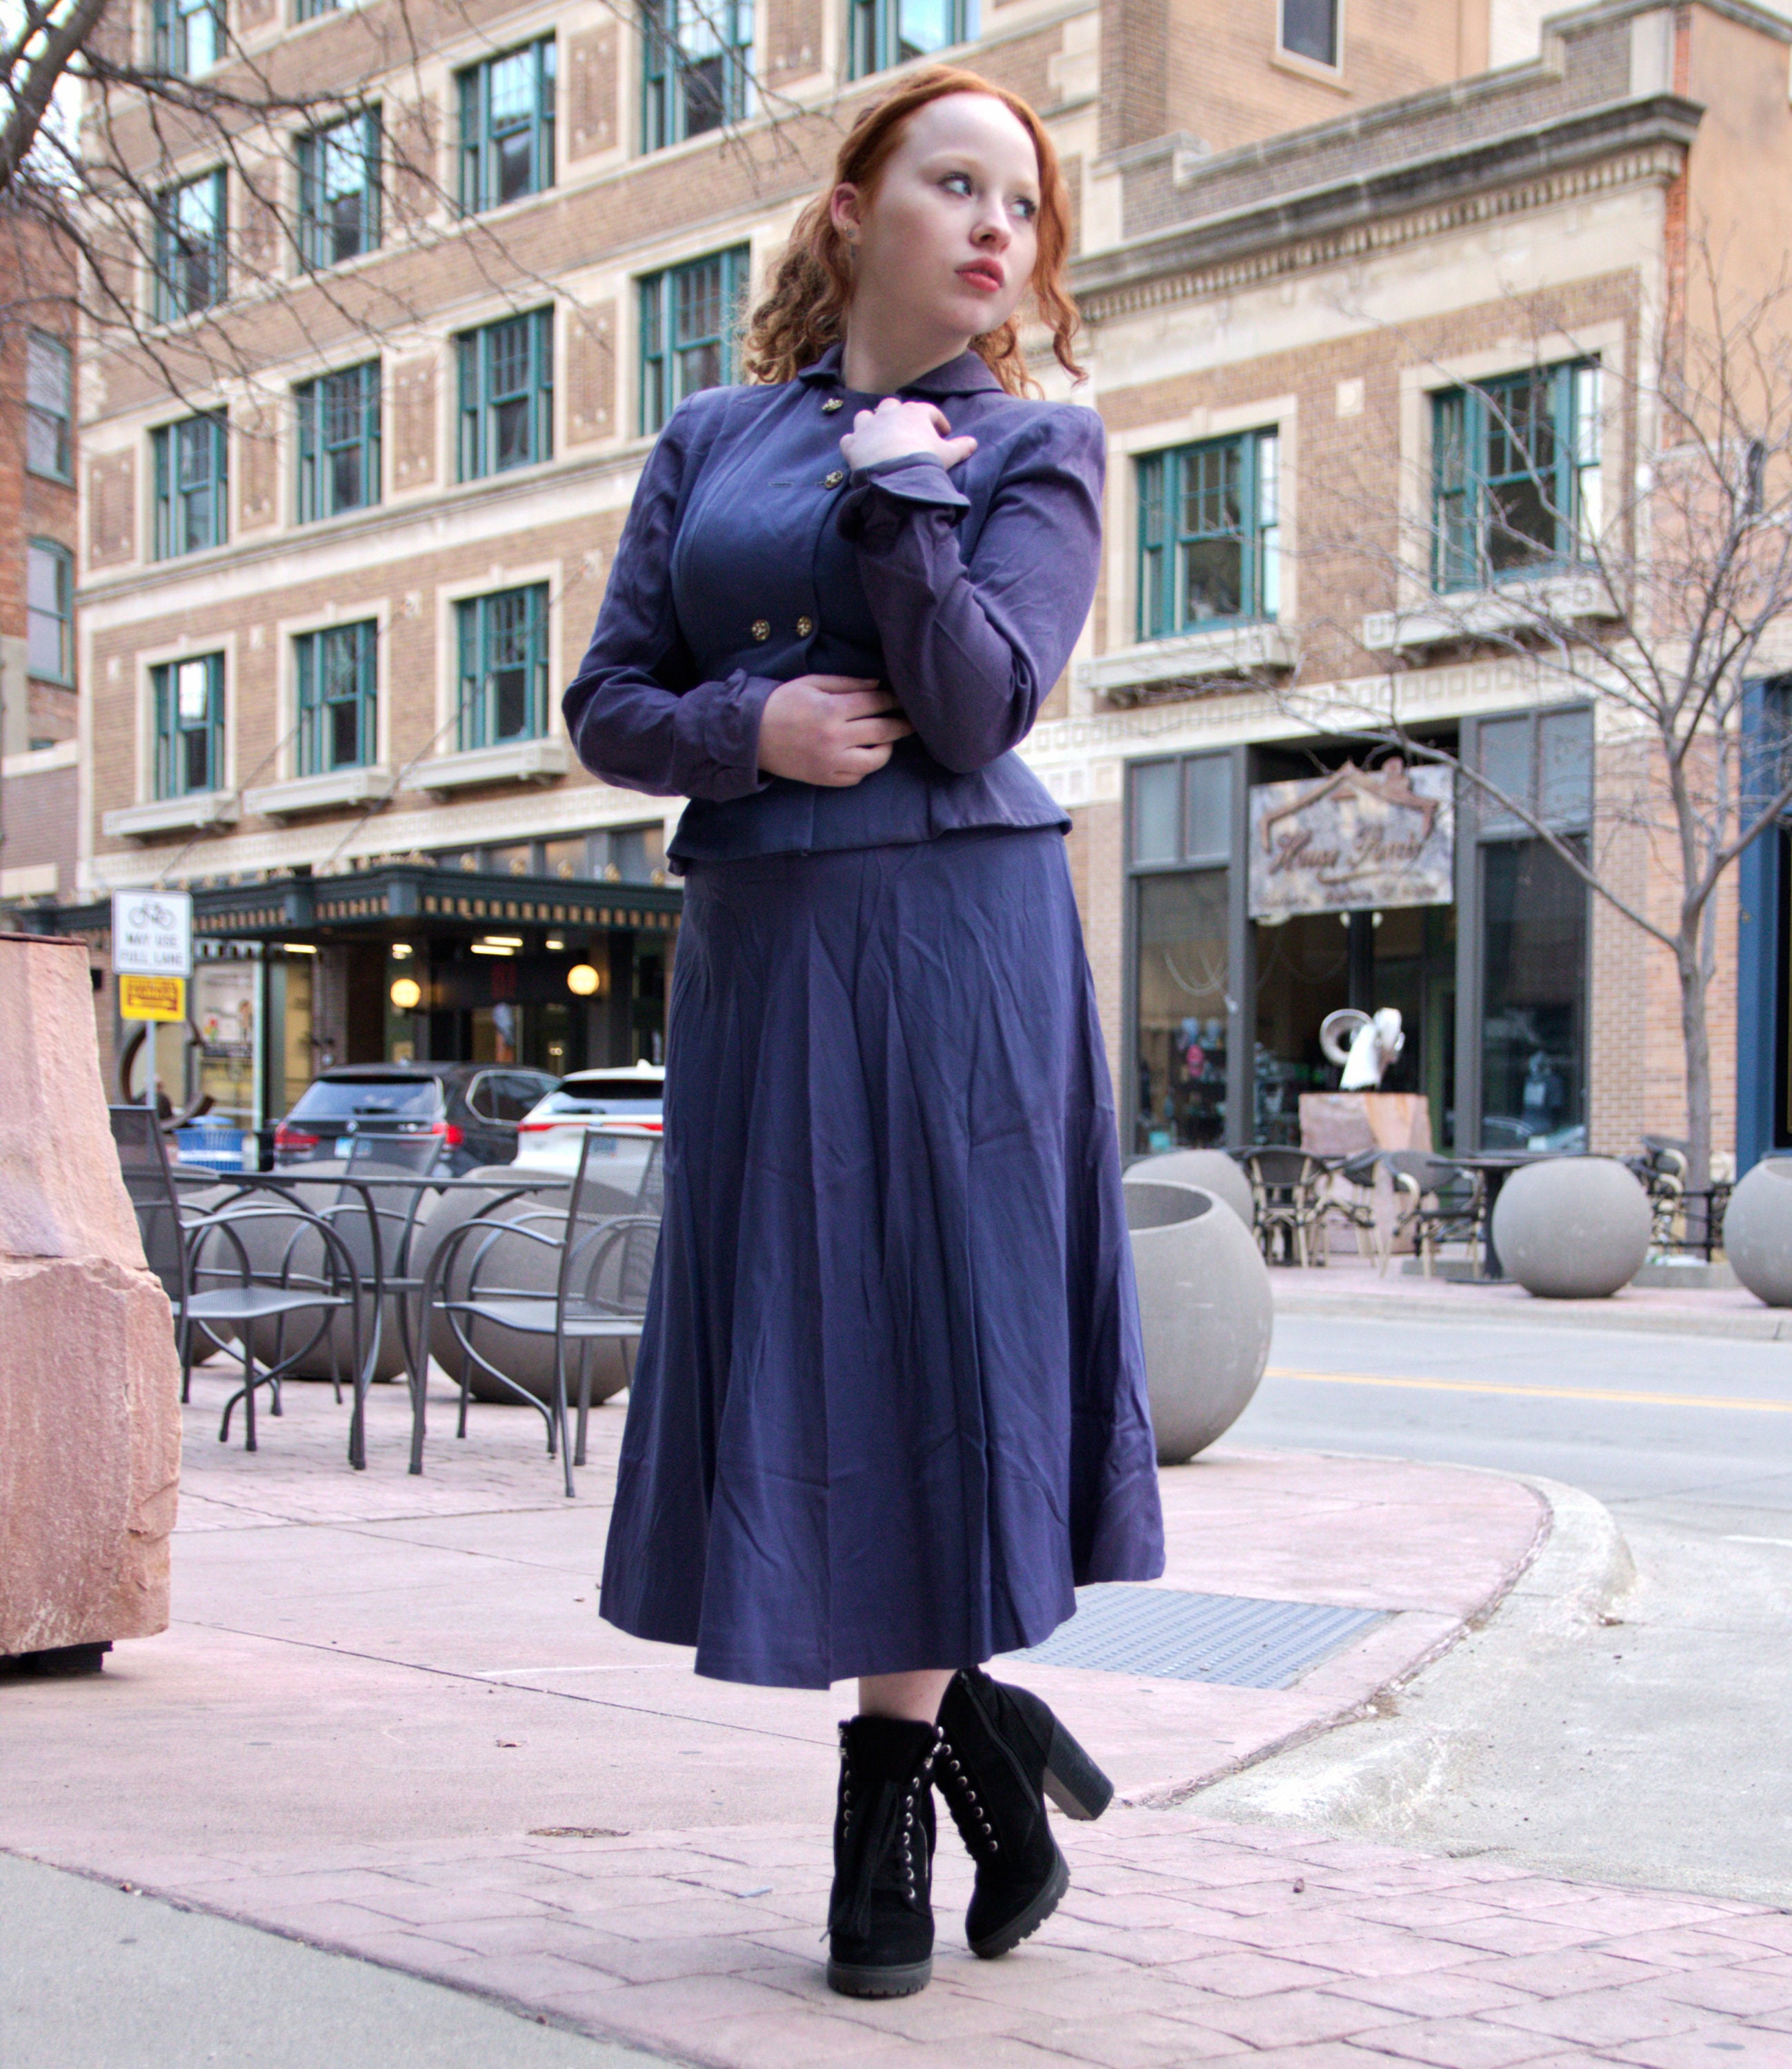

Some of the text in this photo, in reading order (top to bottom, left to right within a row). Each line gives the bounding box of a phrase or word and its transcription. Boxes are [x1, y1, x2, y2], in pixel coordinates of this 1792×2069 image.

[126, 932, 178, 947] MAY USE
[121, 949, 183, 965] FULL LANE
